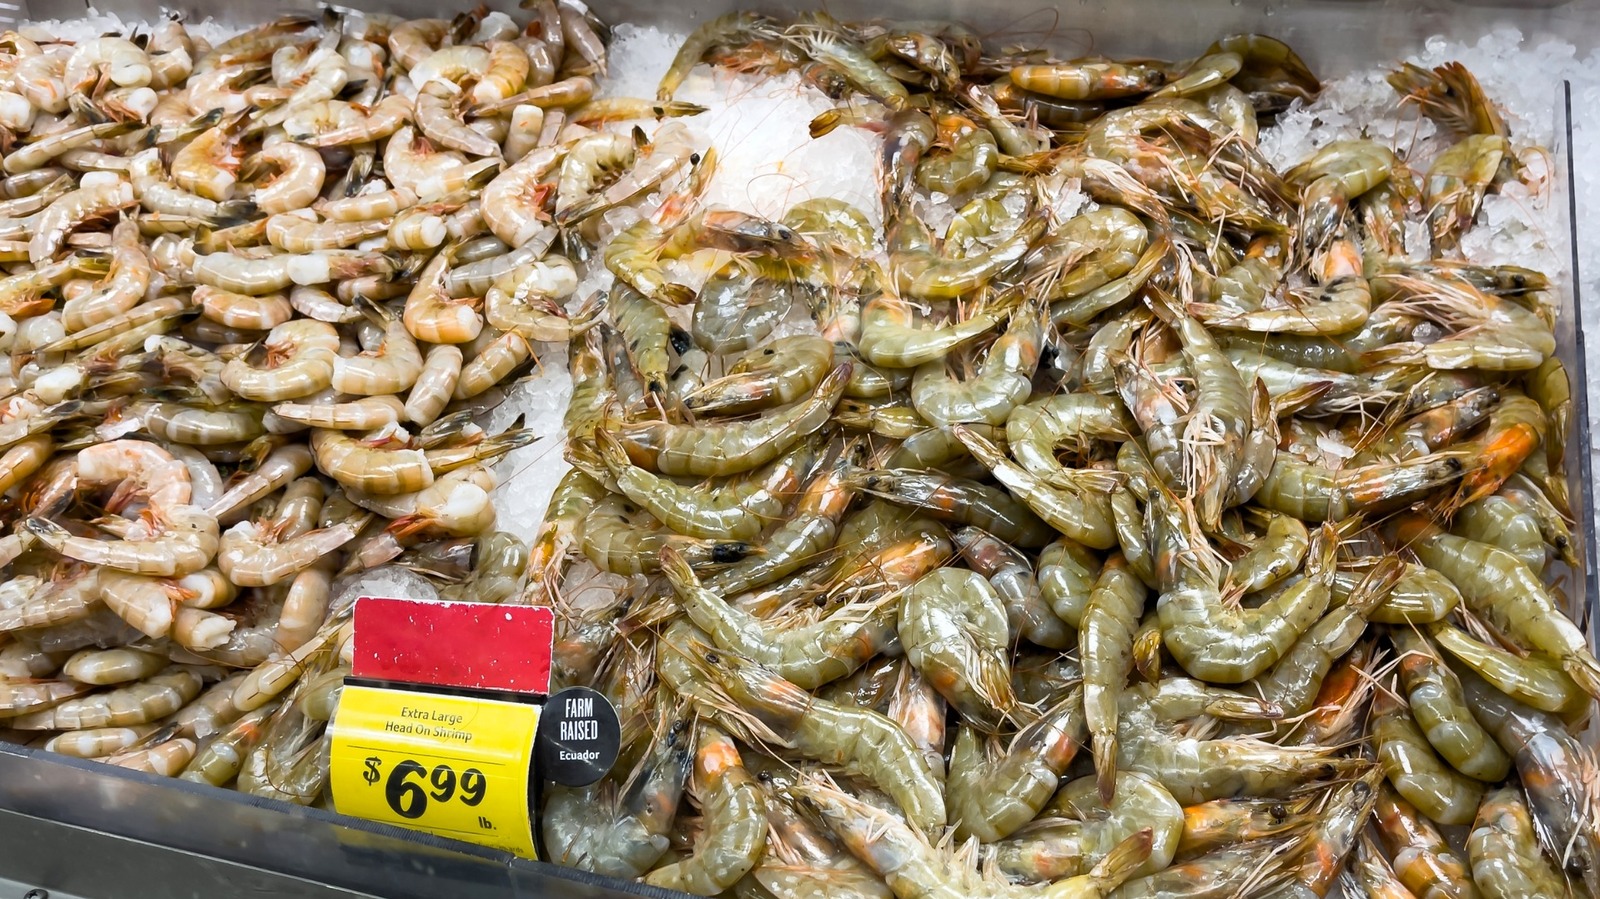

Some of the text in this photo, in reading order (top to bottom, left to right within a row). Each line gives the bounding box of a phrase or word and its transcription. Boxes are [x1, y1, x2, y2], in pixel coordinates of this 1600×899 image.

[401, 706, 463, 726] Extra Large
[565, 697, 593, 718] FARM
[385, 720, 473, 743] Head On Shrimp
[560, 720, 598, 741] RAISED
[559, 749, 600, 761] Ecuador
[478, 816, 497, 831] lb.
